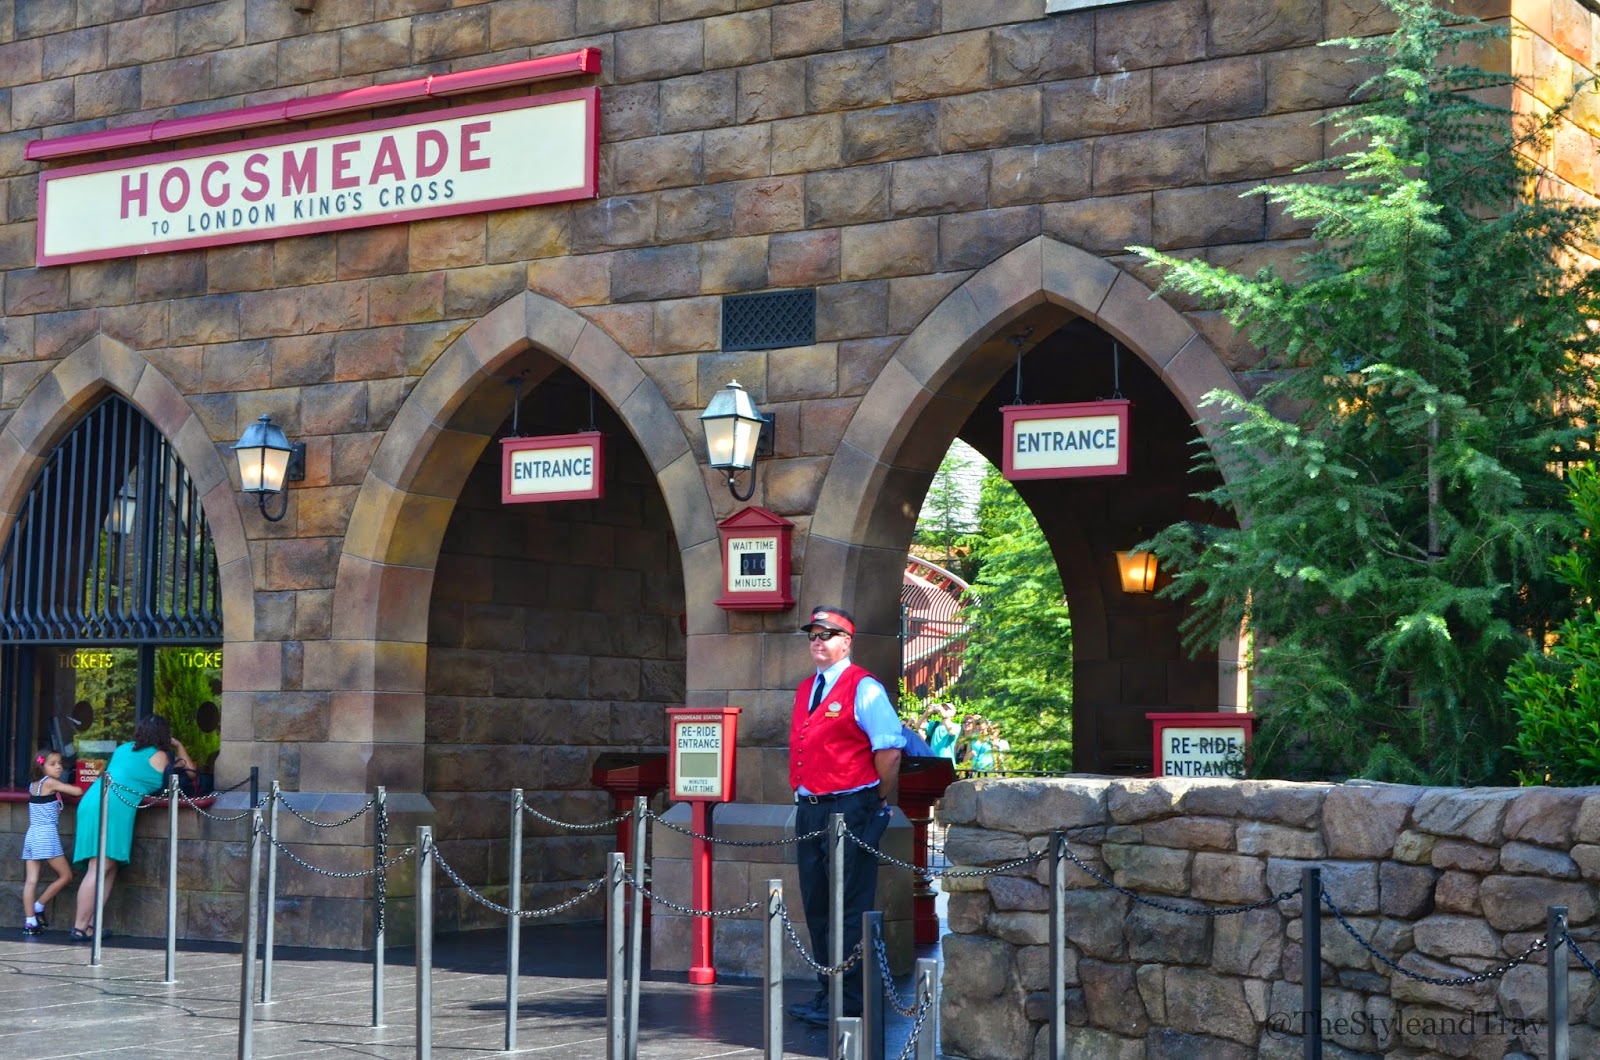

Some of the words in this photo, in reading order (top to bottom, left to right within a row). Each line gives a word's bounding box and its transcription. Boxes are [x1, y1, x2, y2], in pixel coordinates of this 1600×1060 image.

[119, 120, 493, 220] HOGSMEADE
[151, 220, 171, 236] TO
[187, 204, 276, 233] LONDON
[293, 191, 363, 219] KING'S
[378, 179, 456, 207] CROSS
[1015, 428, 1118, 454] ENTRANCE
[513, 456, 593, 481] ENTRANCE
[732, 541, 753, 551] WAIT
[755, 540, 774, 550] TIME
[734, 578, 772, 587] MINUTES
[59, 653, 113, 669] TICKETS
[681, 726, 717, 737] RE-RIDE
[677, 738, 720, 749] ENTRANCE
[1171, 737, 1236, 754] RE-RIDE
[1165, 760, 1245, 777] ENTRANCE
[682, 785, 698, 793] WAIT
[699, 785, 714, 793] TIME
